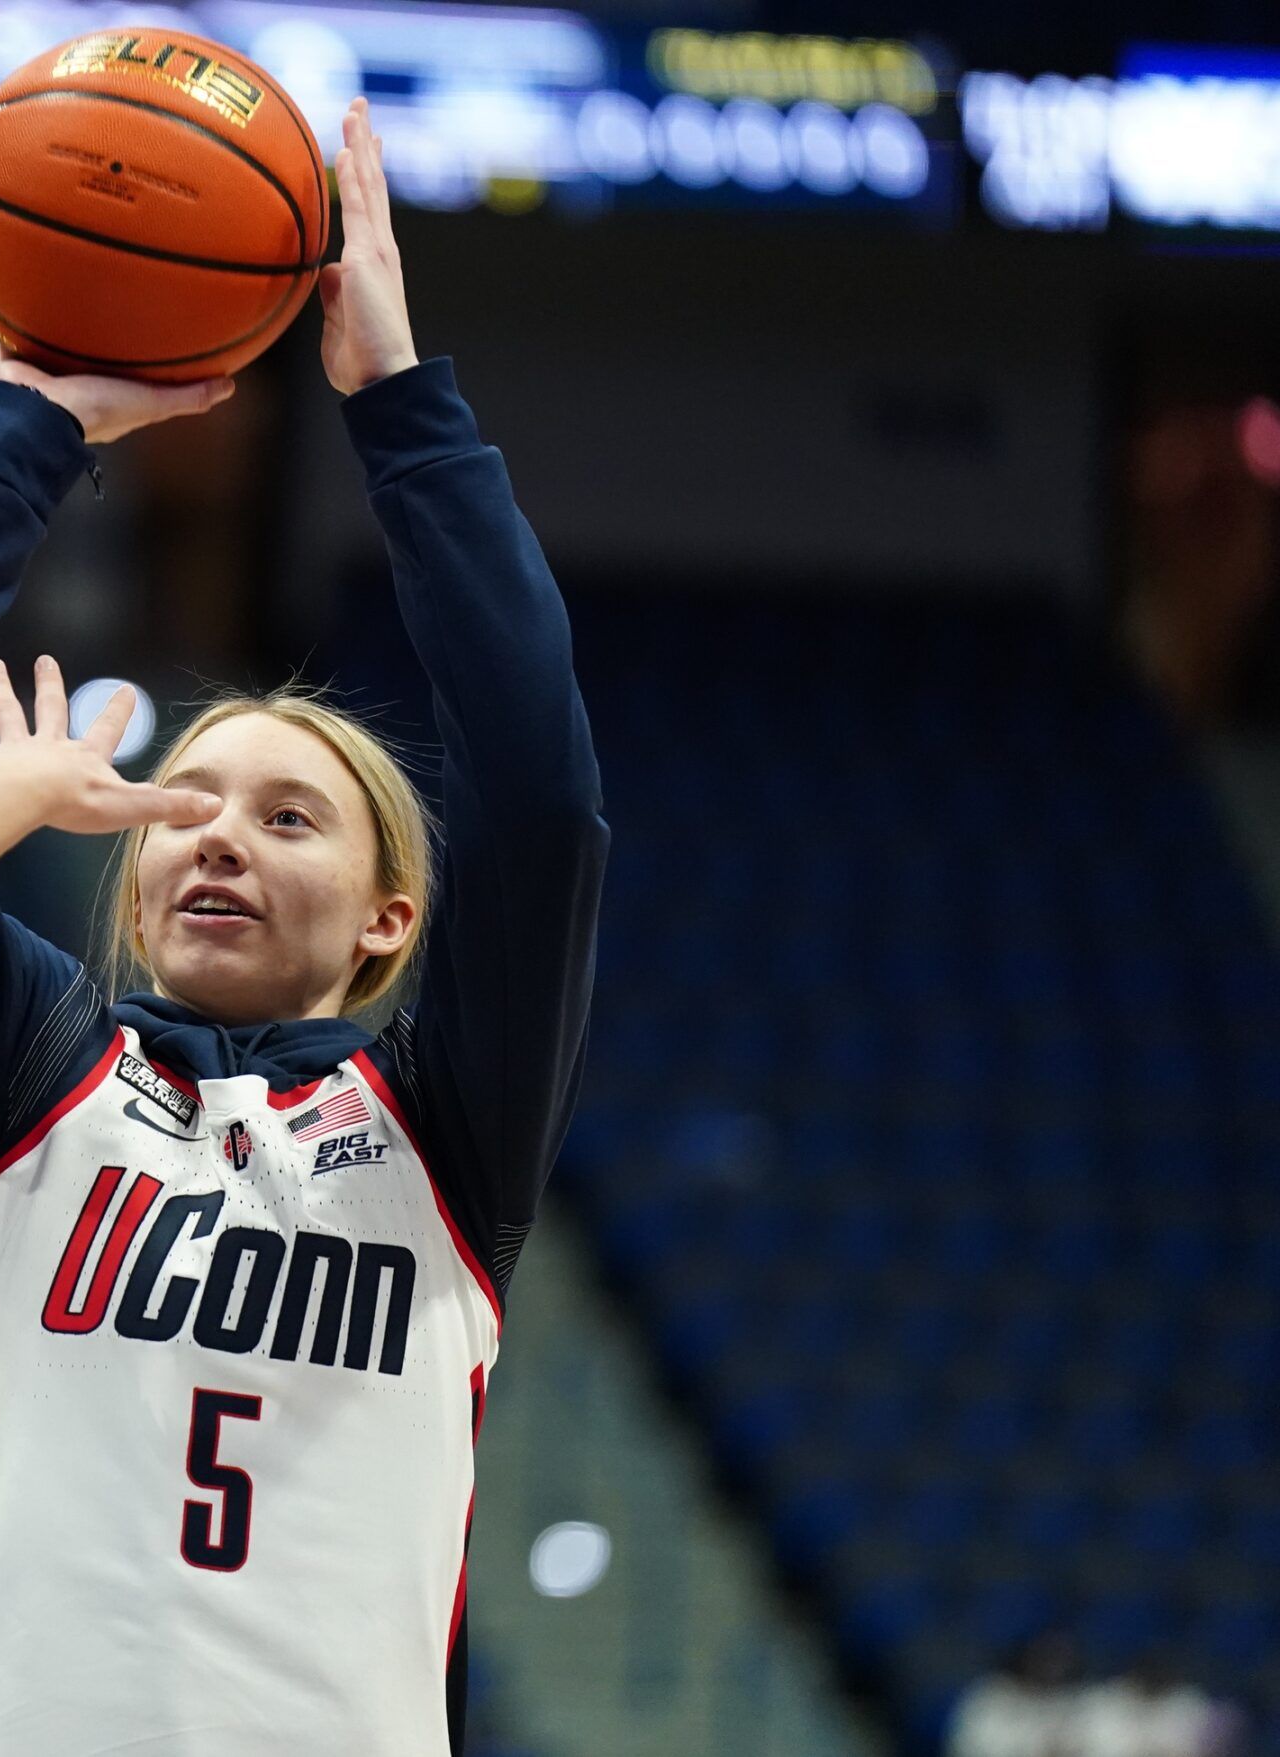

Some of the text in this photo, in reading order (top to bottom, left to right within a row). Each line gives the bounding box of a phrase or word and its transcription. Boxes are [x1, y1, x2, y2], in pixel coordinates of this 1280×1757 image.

[56, 34, 265, 121] ELITE
[120, 1067, 190, 1121] CHANGE
[313, 1144, 389, 1169] EAST
[318, 1132, 369, 1156] BIG
[180, 1387, 262, 1573] 5
